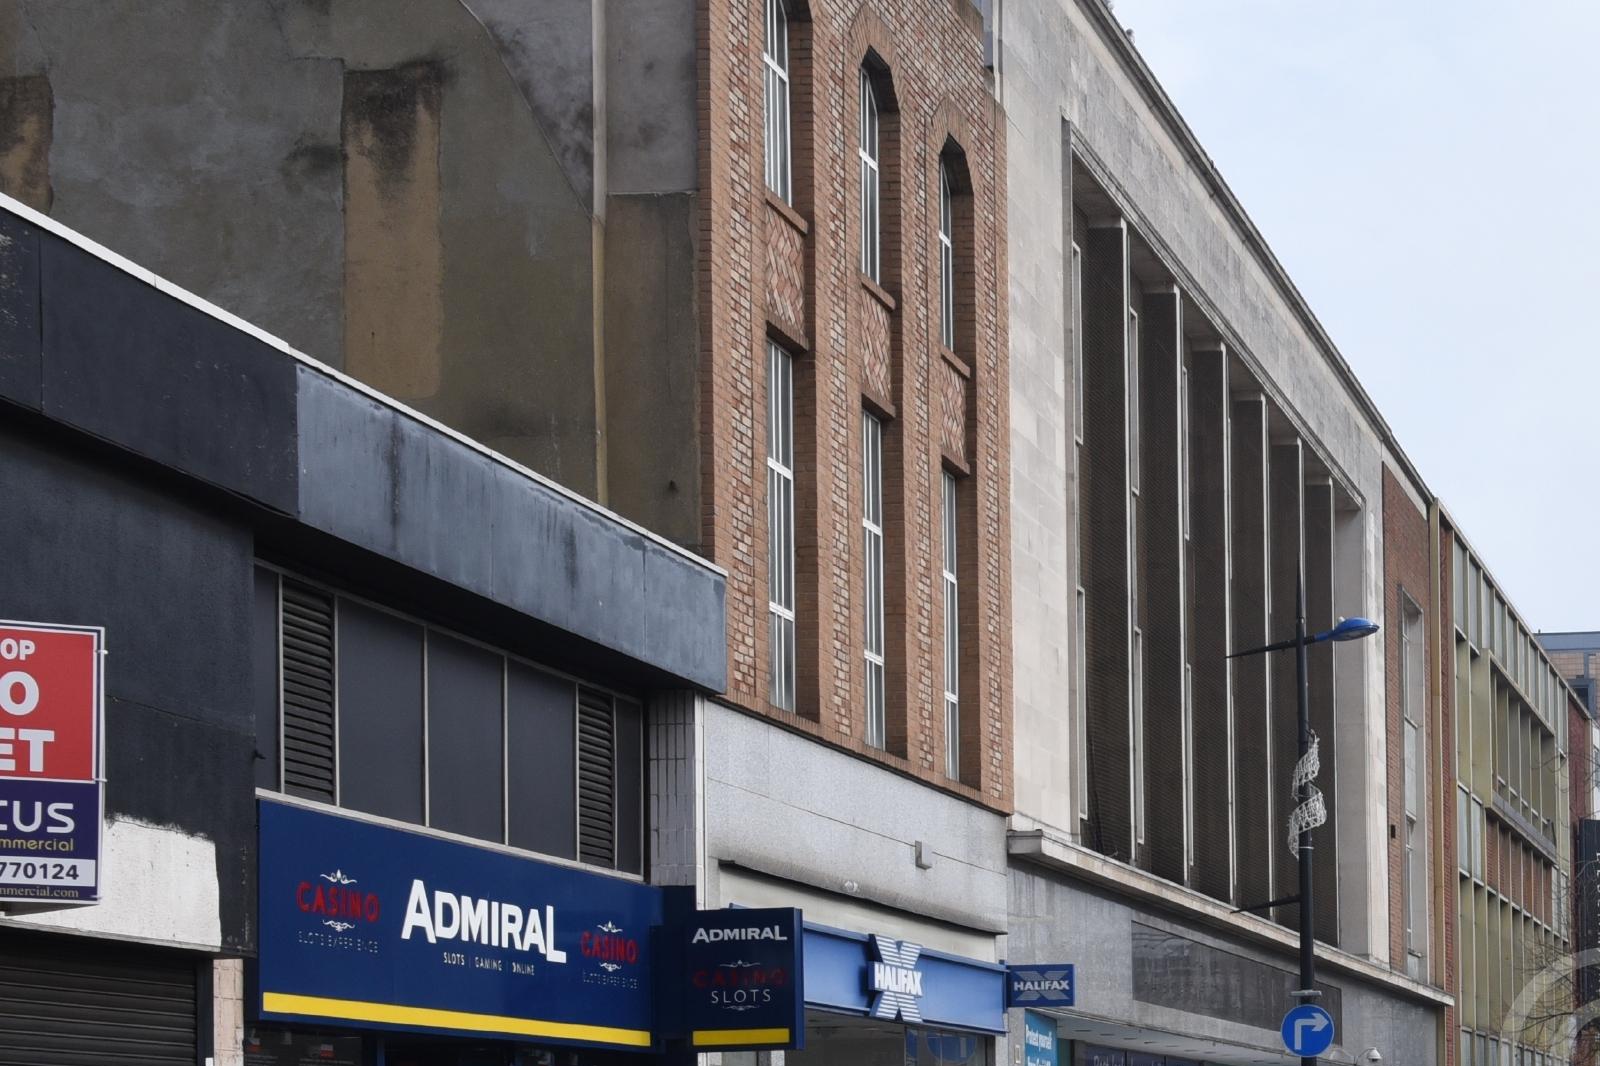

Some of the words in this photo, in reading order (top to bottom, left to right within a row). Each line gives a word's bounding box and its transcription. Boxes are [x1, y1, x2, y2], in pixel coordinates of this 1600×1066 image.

[0, 638, 36, 661] OP
[0, 800, 75, 834] US
[296, 880, 380, 922] CASINO
[401, 879, 567, 964] ADMIRAL
[692, 925, 788, 943] ADMIRAL
[442, 952, 466, 966] SLOTS
[581, 931, 639, 964] CASINO
[874, 962, 923, 996] HALIFAX
[1014, 980, 1069, 991] HALIFAX
[711, 989, 771, 1003] SLOTS
